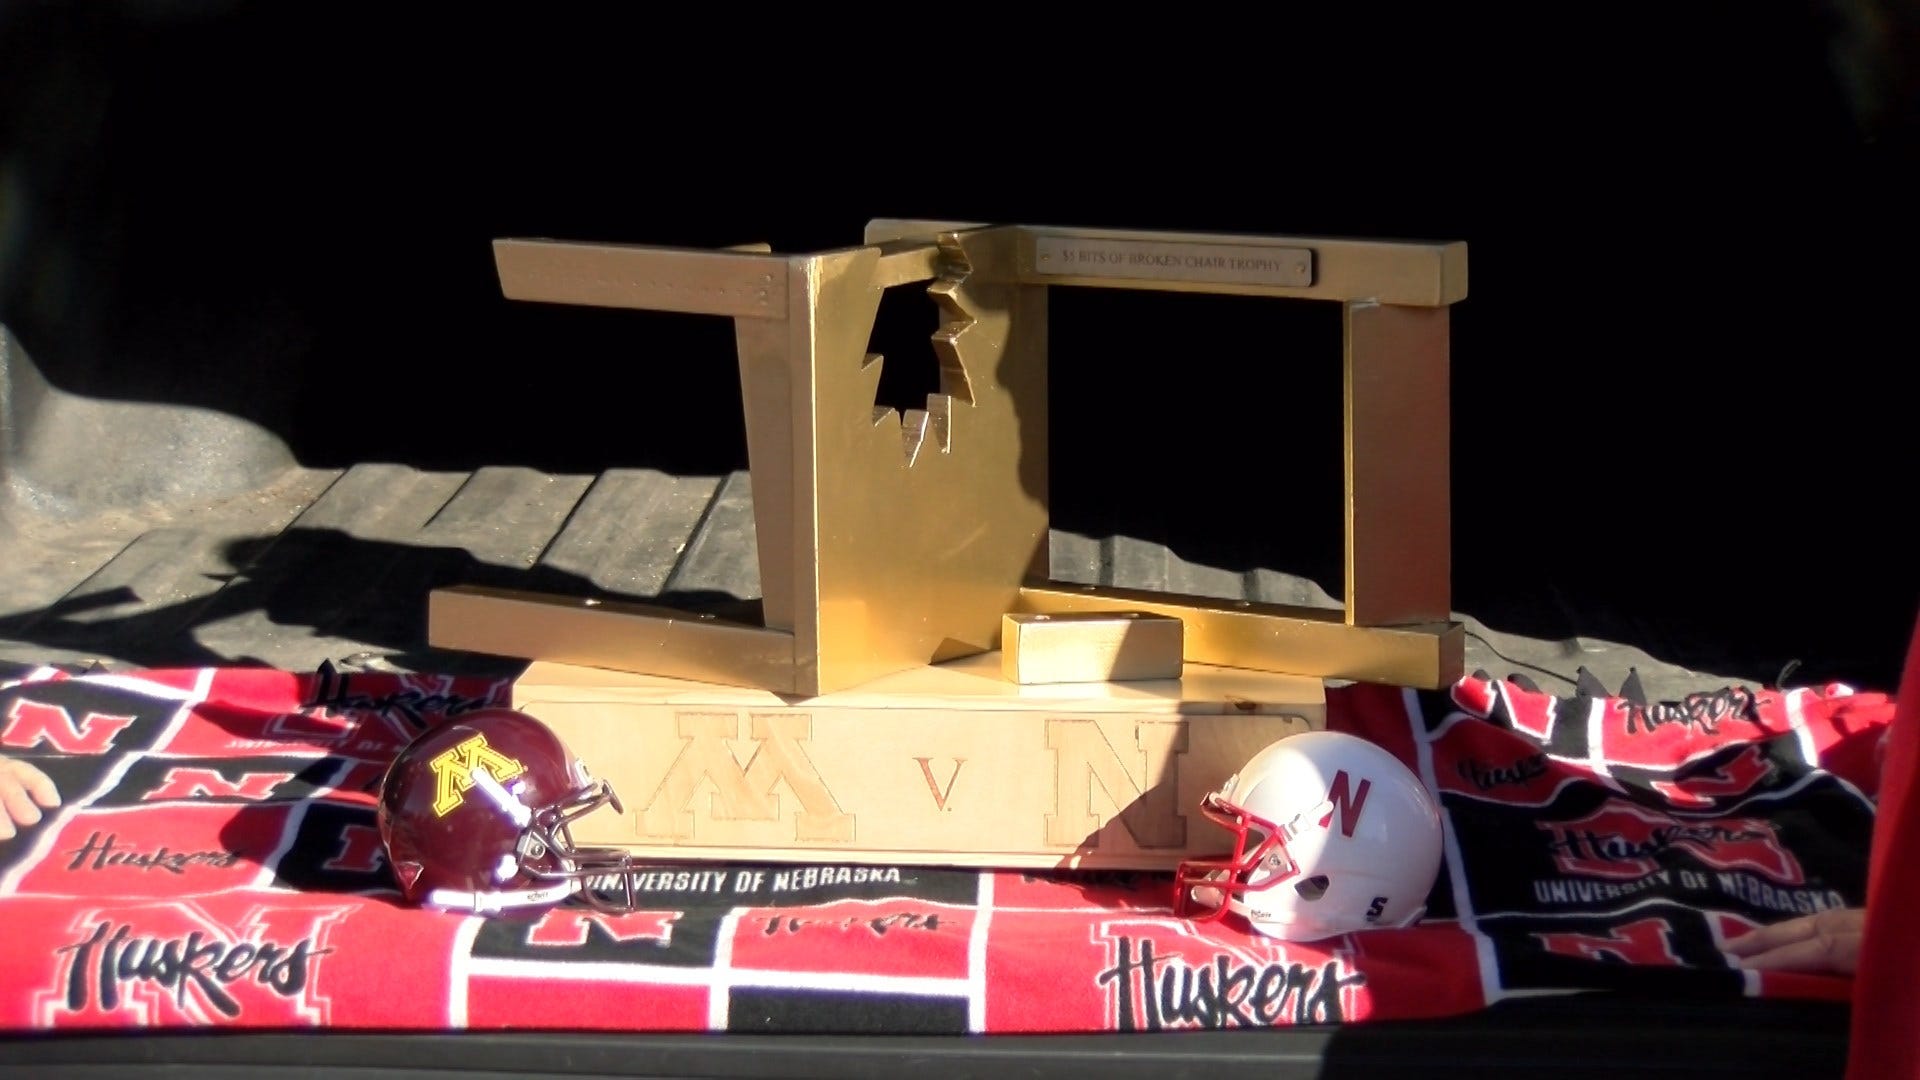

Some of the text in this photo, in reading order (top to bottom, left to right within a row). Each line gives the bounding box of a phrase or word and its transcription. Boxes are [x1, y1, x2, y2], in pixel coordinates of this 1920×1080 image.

[1078, 250, 1107, 265] BITS
[1109, 251, 1125, 265] OF
[1129, 252, 1184, 268] BROKEN
[1185, 254, 1225, 270] CHAIR
[1229, 256, 1282, 272] TROPHY
[431, 731, 526, 818] M
[635, 712, 857, 842] M
[1044, 719, 1190, 849] N
[1317, 768, 1372, 838] N
[734, 871, 764, 893] OF
[774, 867, 901, 892] NEBRASKA
[1533, 870, 1671, 903] UNIVERSITY
[1680, 869, 1708, 889] OF
[58, 921, 332, 1017] Huskers
[1098, 936, 1366, 1031] Huskers
